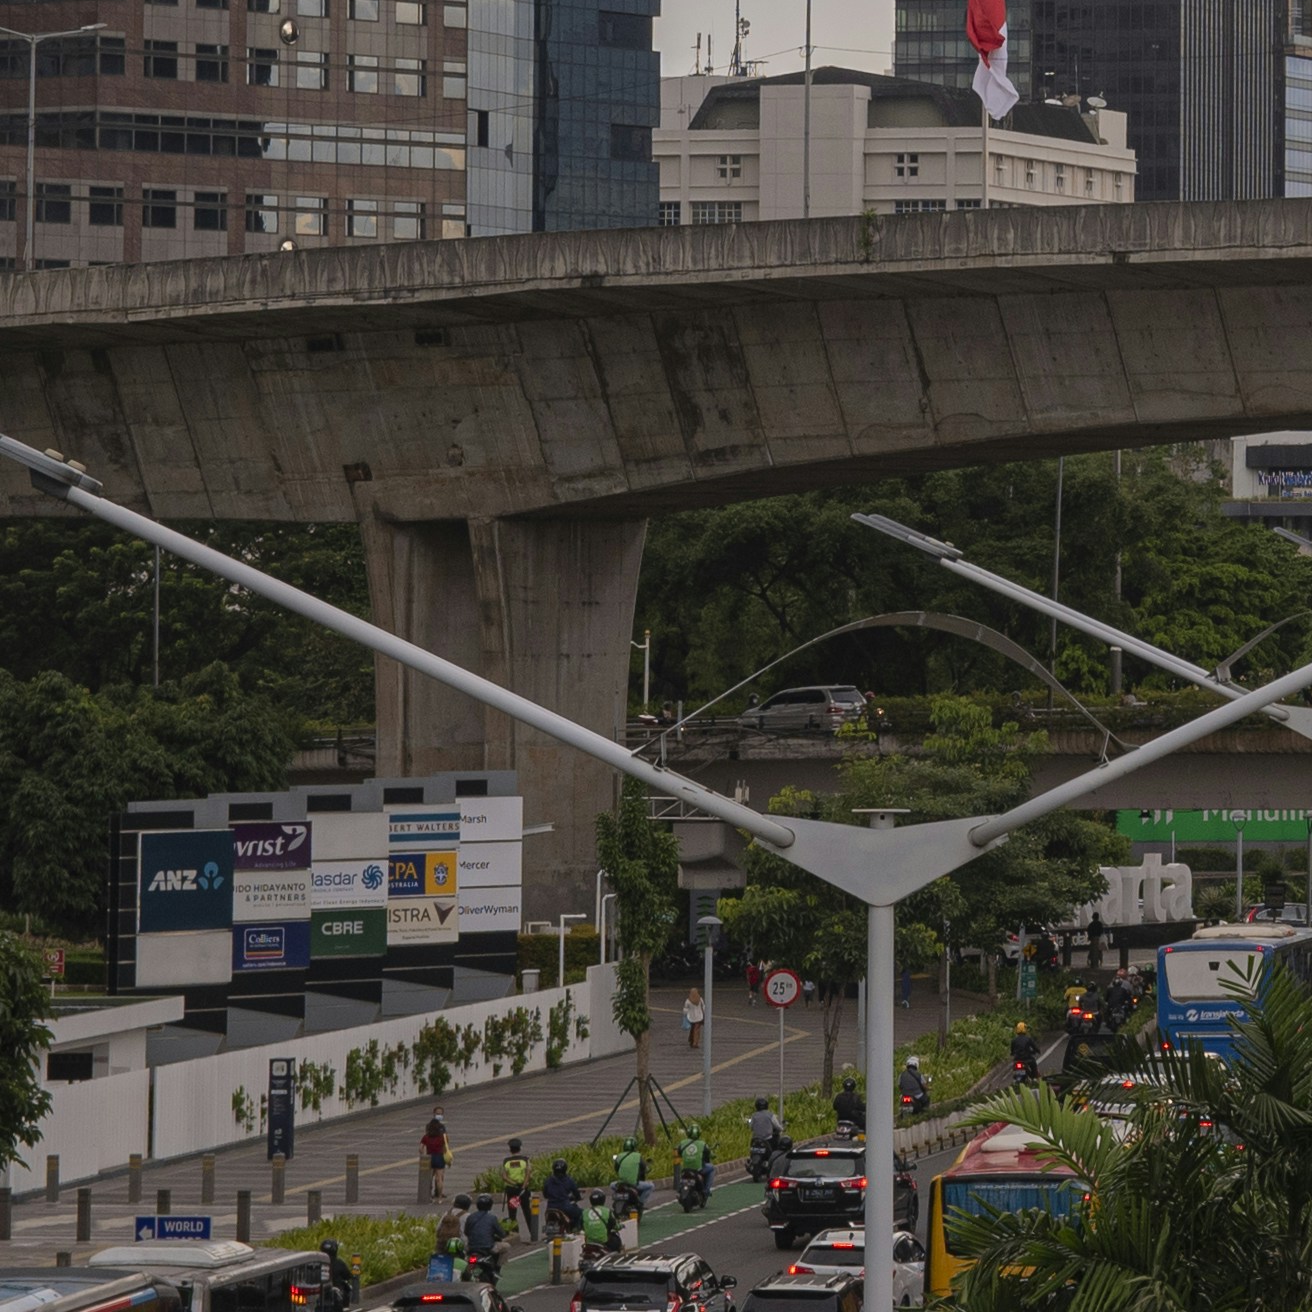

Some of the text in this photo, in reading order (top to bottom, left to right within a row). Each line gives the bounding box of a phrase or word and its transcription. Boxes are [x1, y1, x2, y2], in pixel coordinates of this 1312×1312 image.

[460, 814, 487, 824] Marsh
[416, 822, 459, 831] WALTERS
[234, 836, 285, 857] vrist
[460, 861, 490, 870] Mercer
[148, 869, 198, 892] ANZ
[233, 885, 252, 894] IDO
[253, 883, 306, 892] HIDAYANTO
[253, 894, 306, 902] PARTNERS
[388, 908, 431, 924] ISTRA
[321, 920, 364, 935] CBRE
[248, 934, 280, 944] Colliers
[773, 982, 785, 995] 25
[164, 1221, 204, 1233] WORLD
